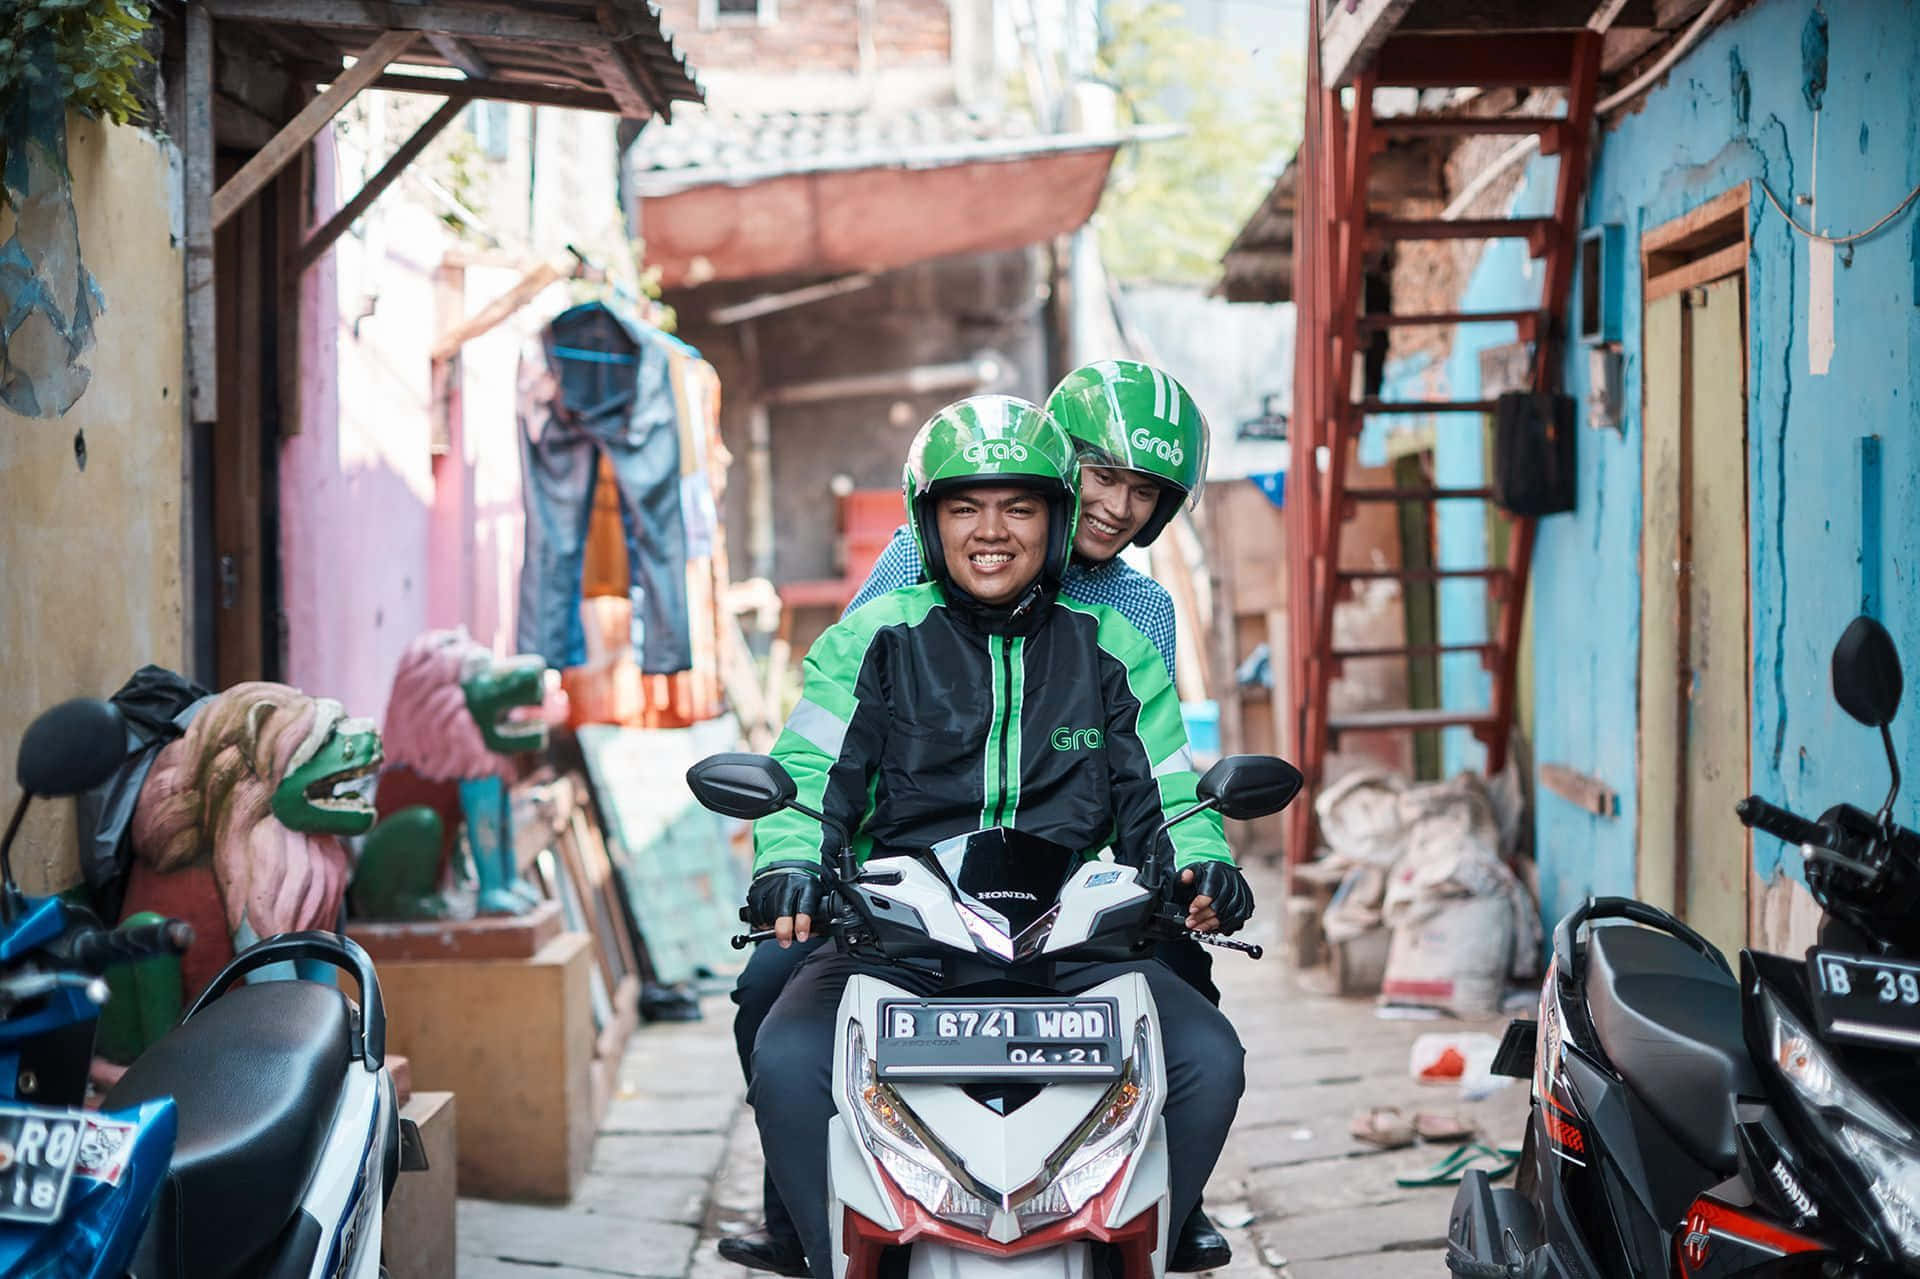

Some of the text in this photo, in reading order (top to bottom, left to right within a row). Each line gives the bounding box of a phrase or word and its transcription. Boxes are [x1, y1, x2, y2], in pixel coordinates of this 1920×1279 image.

[963, 438, 1028, 463] Grab
[1131, 428, 1184, 466] Grab
[1051, 726, 1103, 751] Gra
[977, 890, 1037, 901] HONDA
[1827, 963, 1919, 1004] B 39
[894, 1012, 915, 1038] B
[938, 1011, 1016, 1038] 6741
[1772, 1160, 1818, 1217] HONDA
